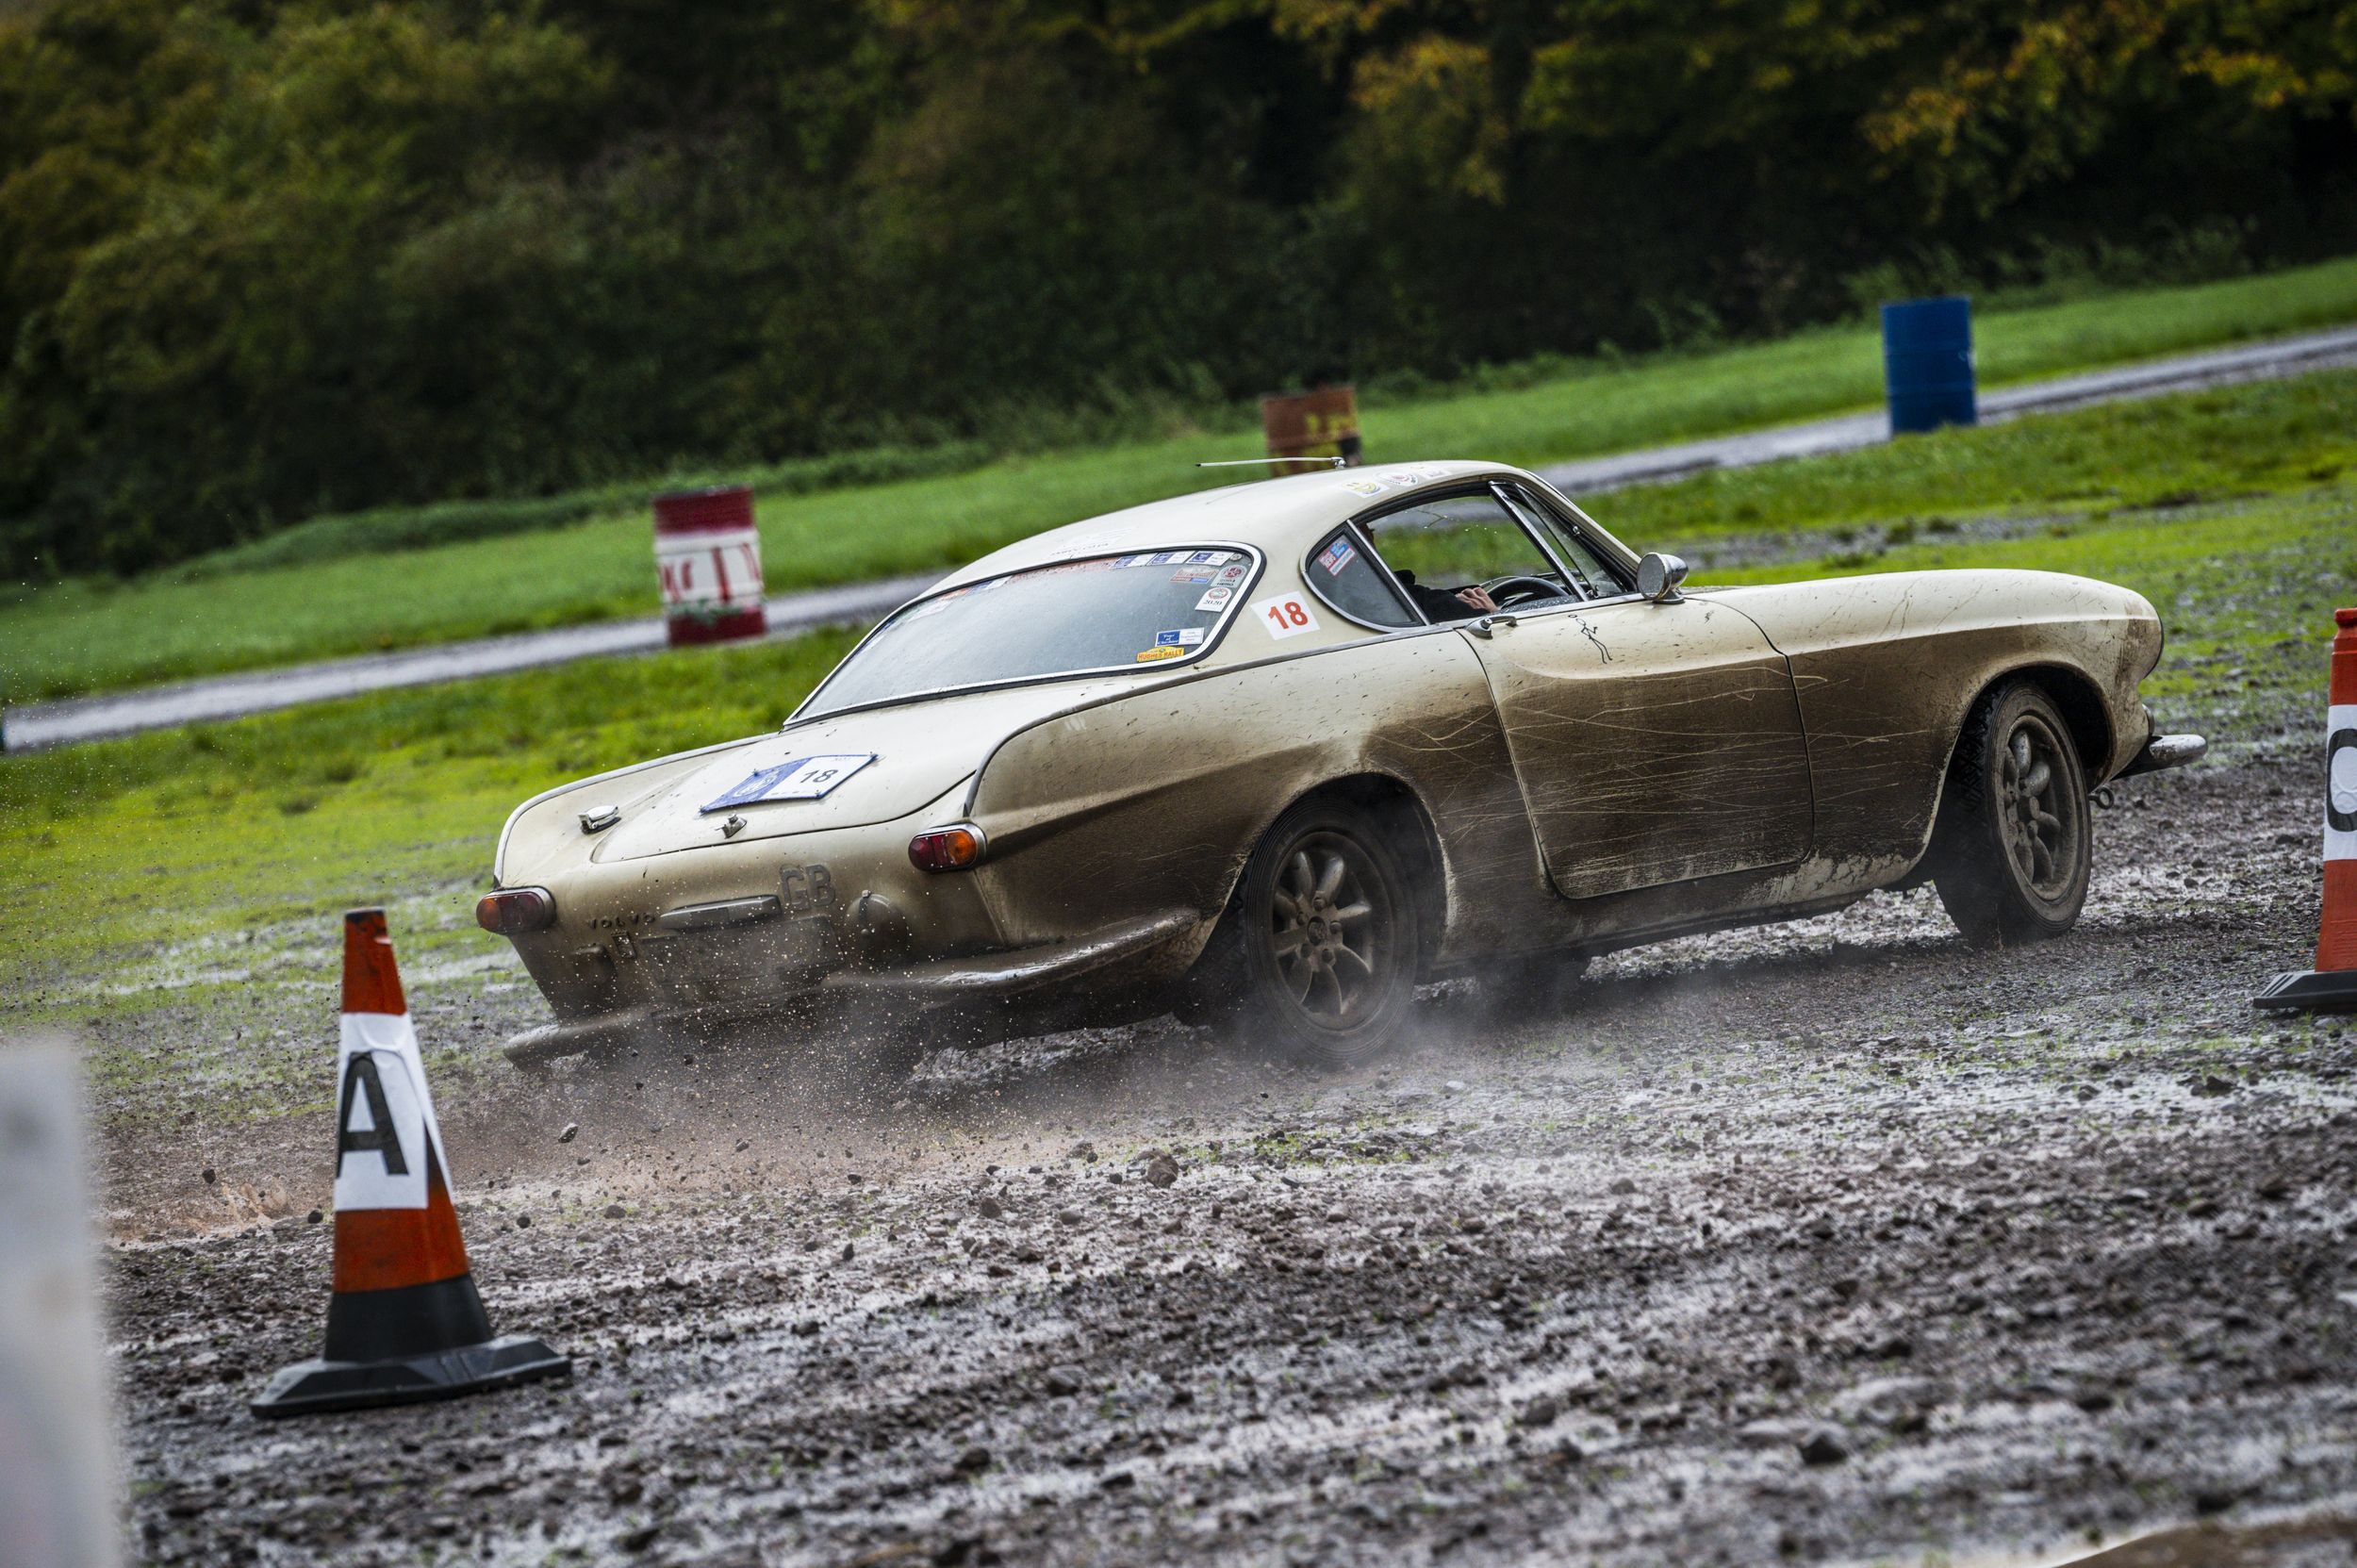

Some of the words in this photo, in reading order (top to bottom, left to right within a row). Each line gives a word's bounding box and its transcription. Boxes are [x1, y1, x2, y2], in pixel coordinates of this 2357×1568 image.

[1268, 602, 1309, 629] 18
[1163, 648, 1183, 658] RALLY
[799, 768, 838, 784] 18
[781, 865, 835, 911] GB
[585, 913, 656, 930] VOLVO
[337, 1051, 409, 1179] A
